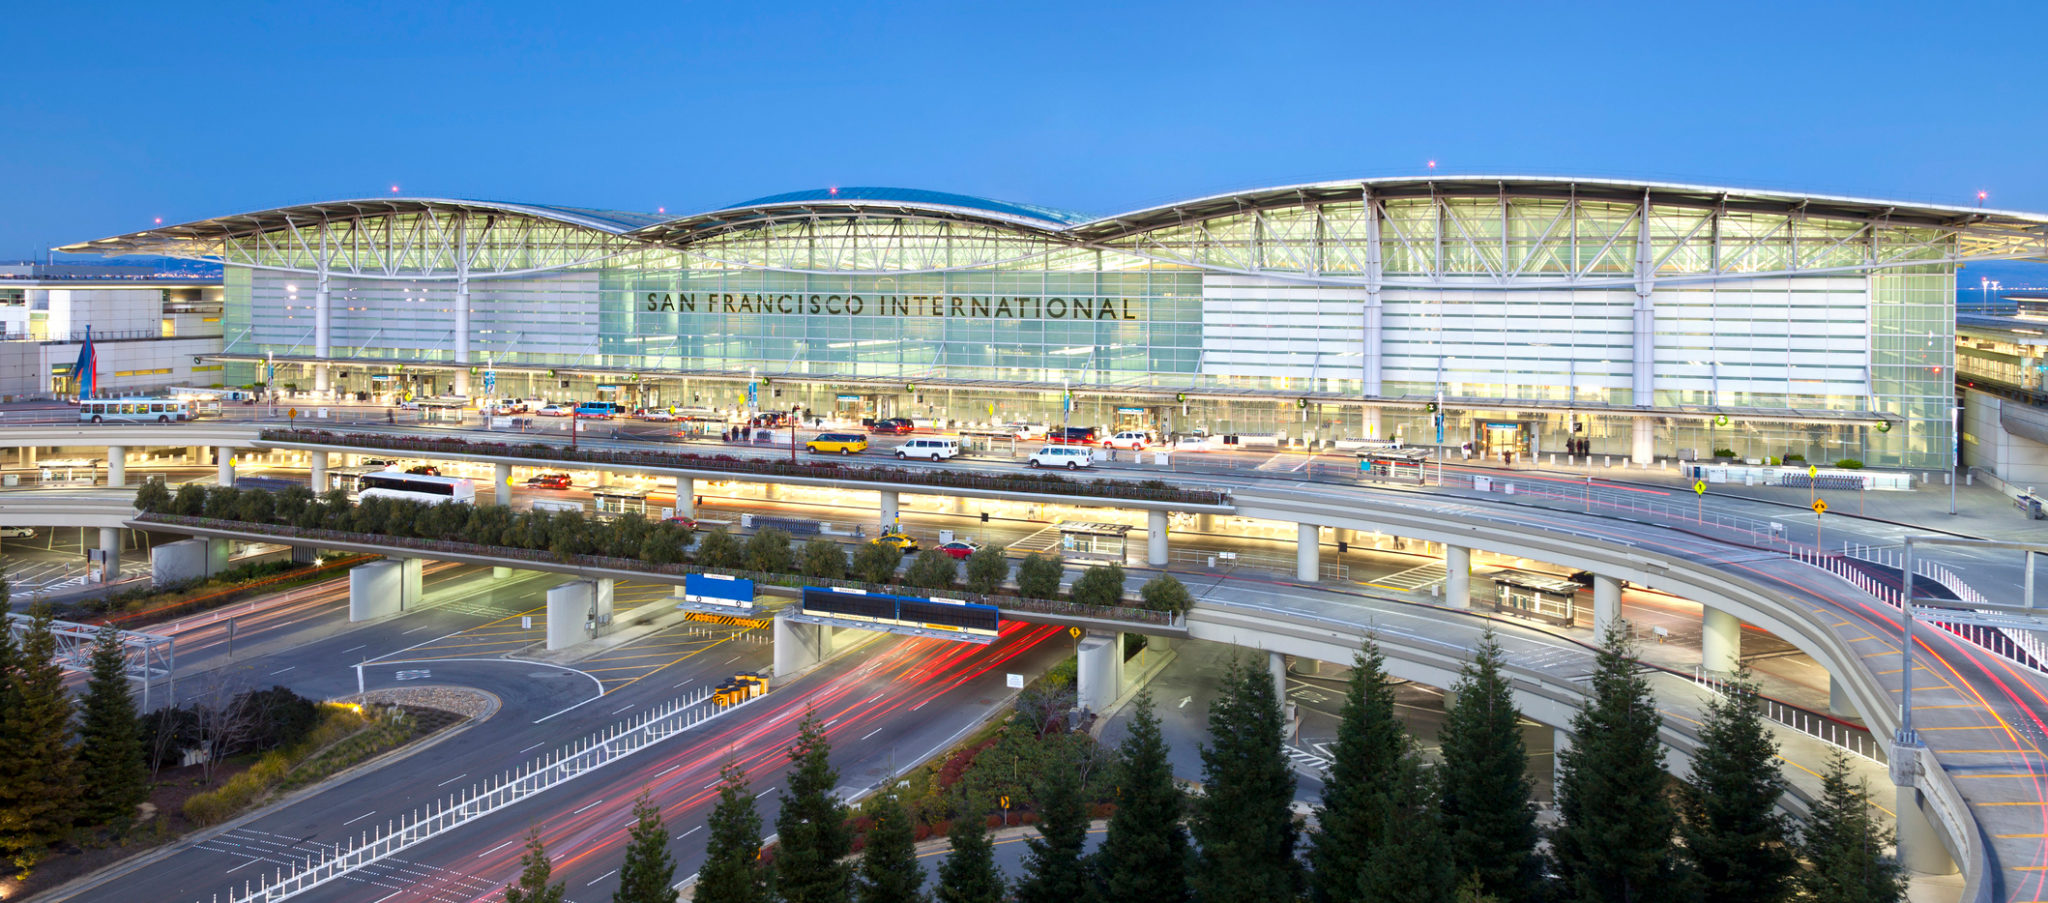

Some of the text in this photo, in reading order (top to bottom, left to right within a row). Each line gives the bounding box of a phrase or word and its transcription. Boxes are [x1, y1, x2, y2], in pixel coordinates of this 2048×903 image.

[647, 292, 1136, 320] SAN FRANCISCO INTERNATIONAL
